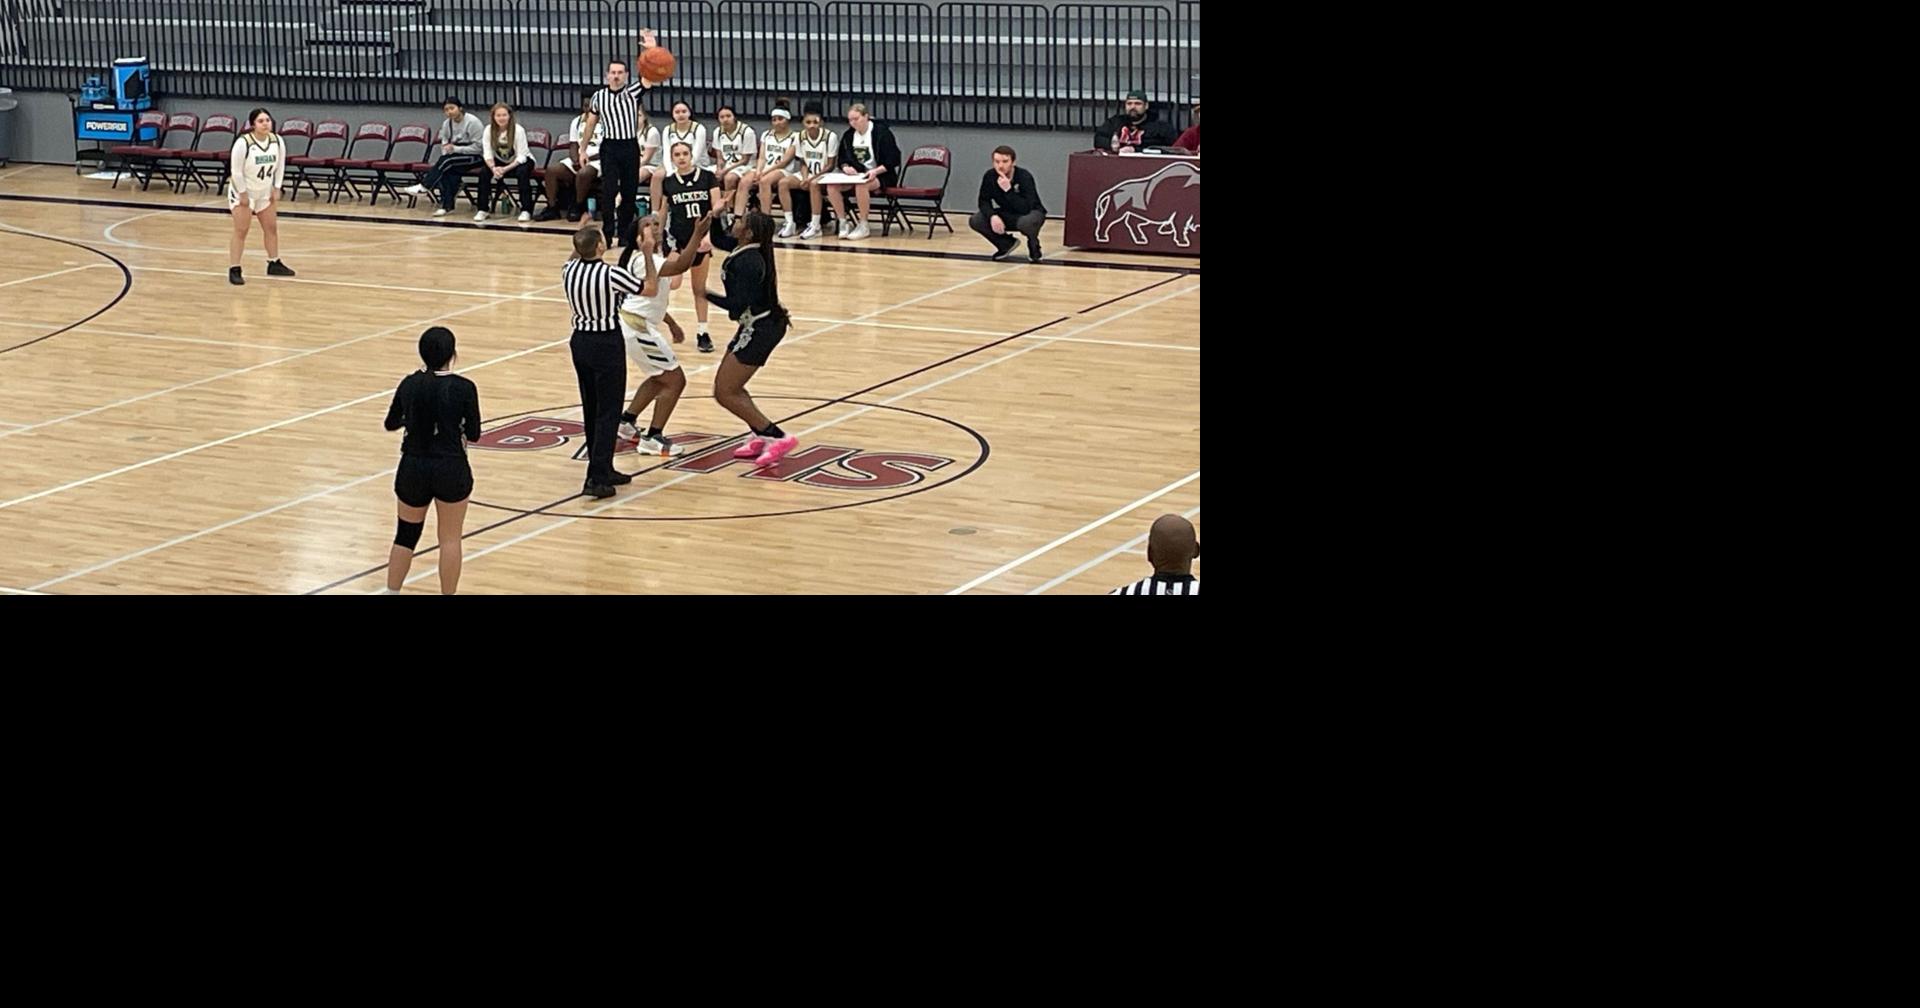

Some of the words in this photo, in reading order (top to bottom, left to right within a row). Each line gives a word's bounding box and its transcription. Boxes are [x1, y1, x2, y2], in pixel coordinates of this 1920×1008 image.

[86, 121, 127, 131] POWERADE
[257, 165, 274, 180] 44
[672, 191, 709, 204] PACKERS
[685, 203, 702, 218] 10
